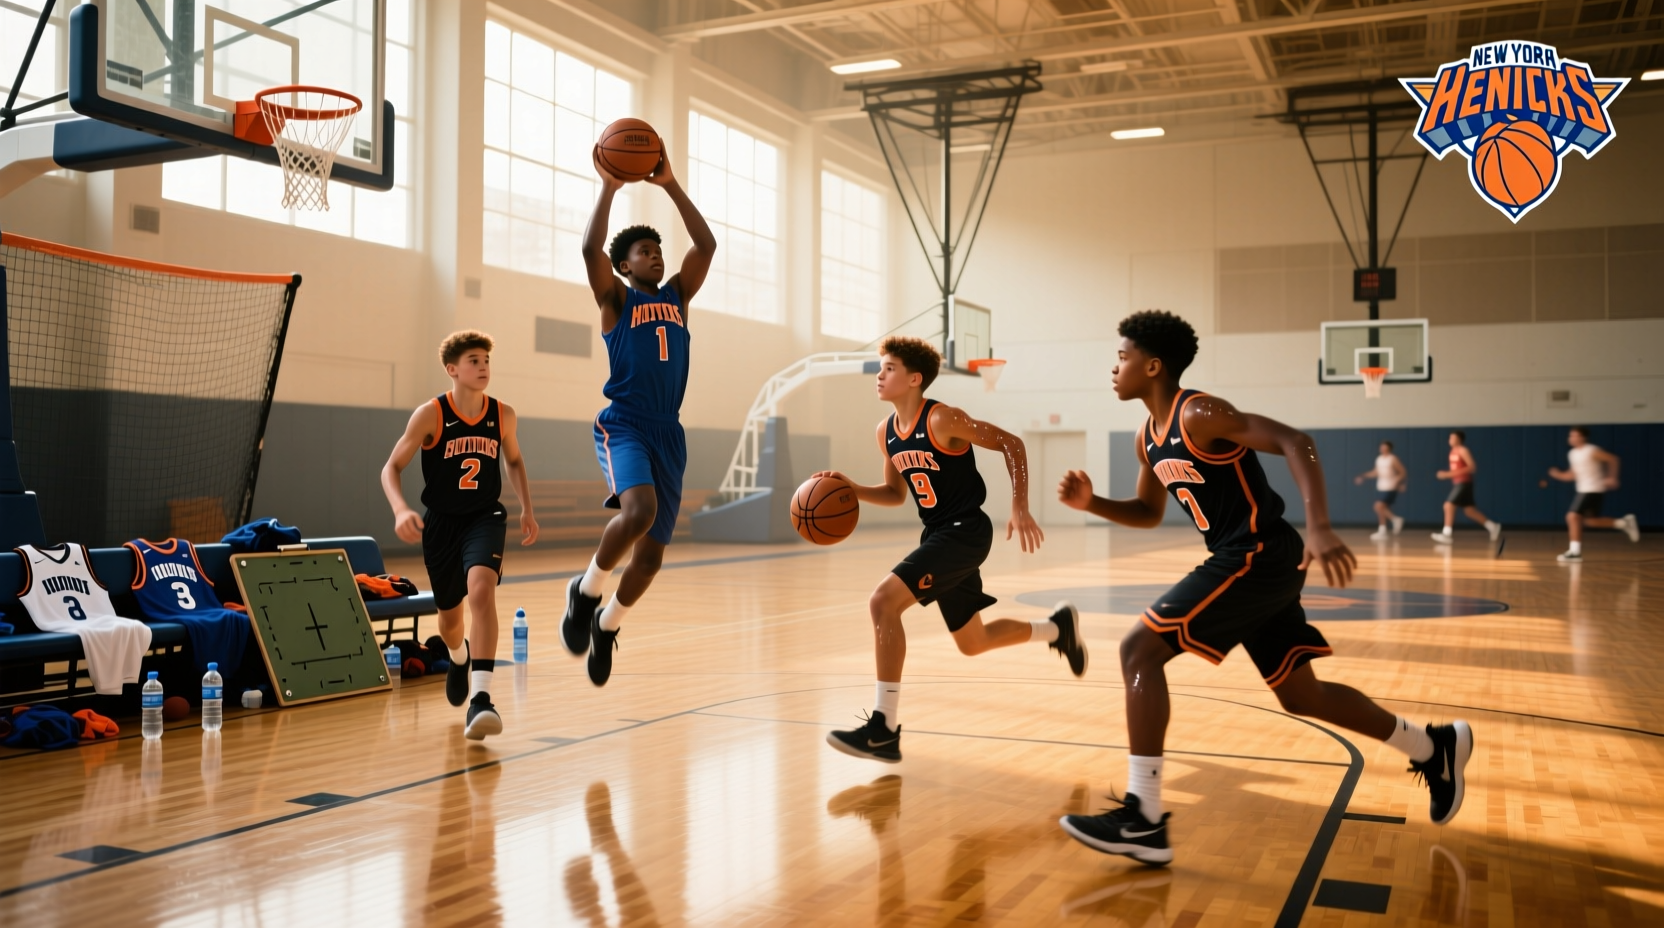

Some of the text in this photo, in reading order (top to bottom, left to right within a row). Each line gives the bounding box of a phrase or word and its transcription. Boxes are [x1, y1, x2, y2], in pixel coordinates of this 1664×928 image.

[655, 326, 669, 361] 1
[459, 458, 481, 490] 2
[910, 472, 938, 509] 9
[171, 581, 196, 610] 3
